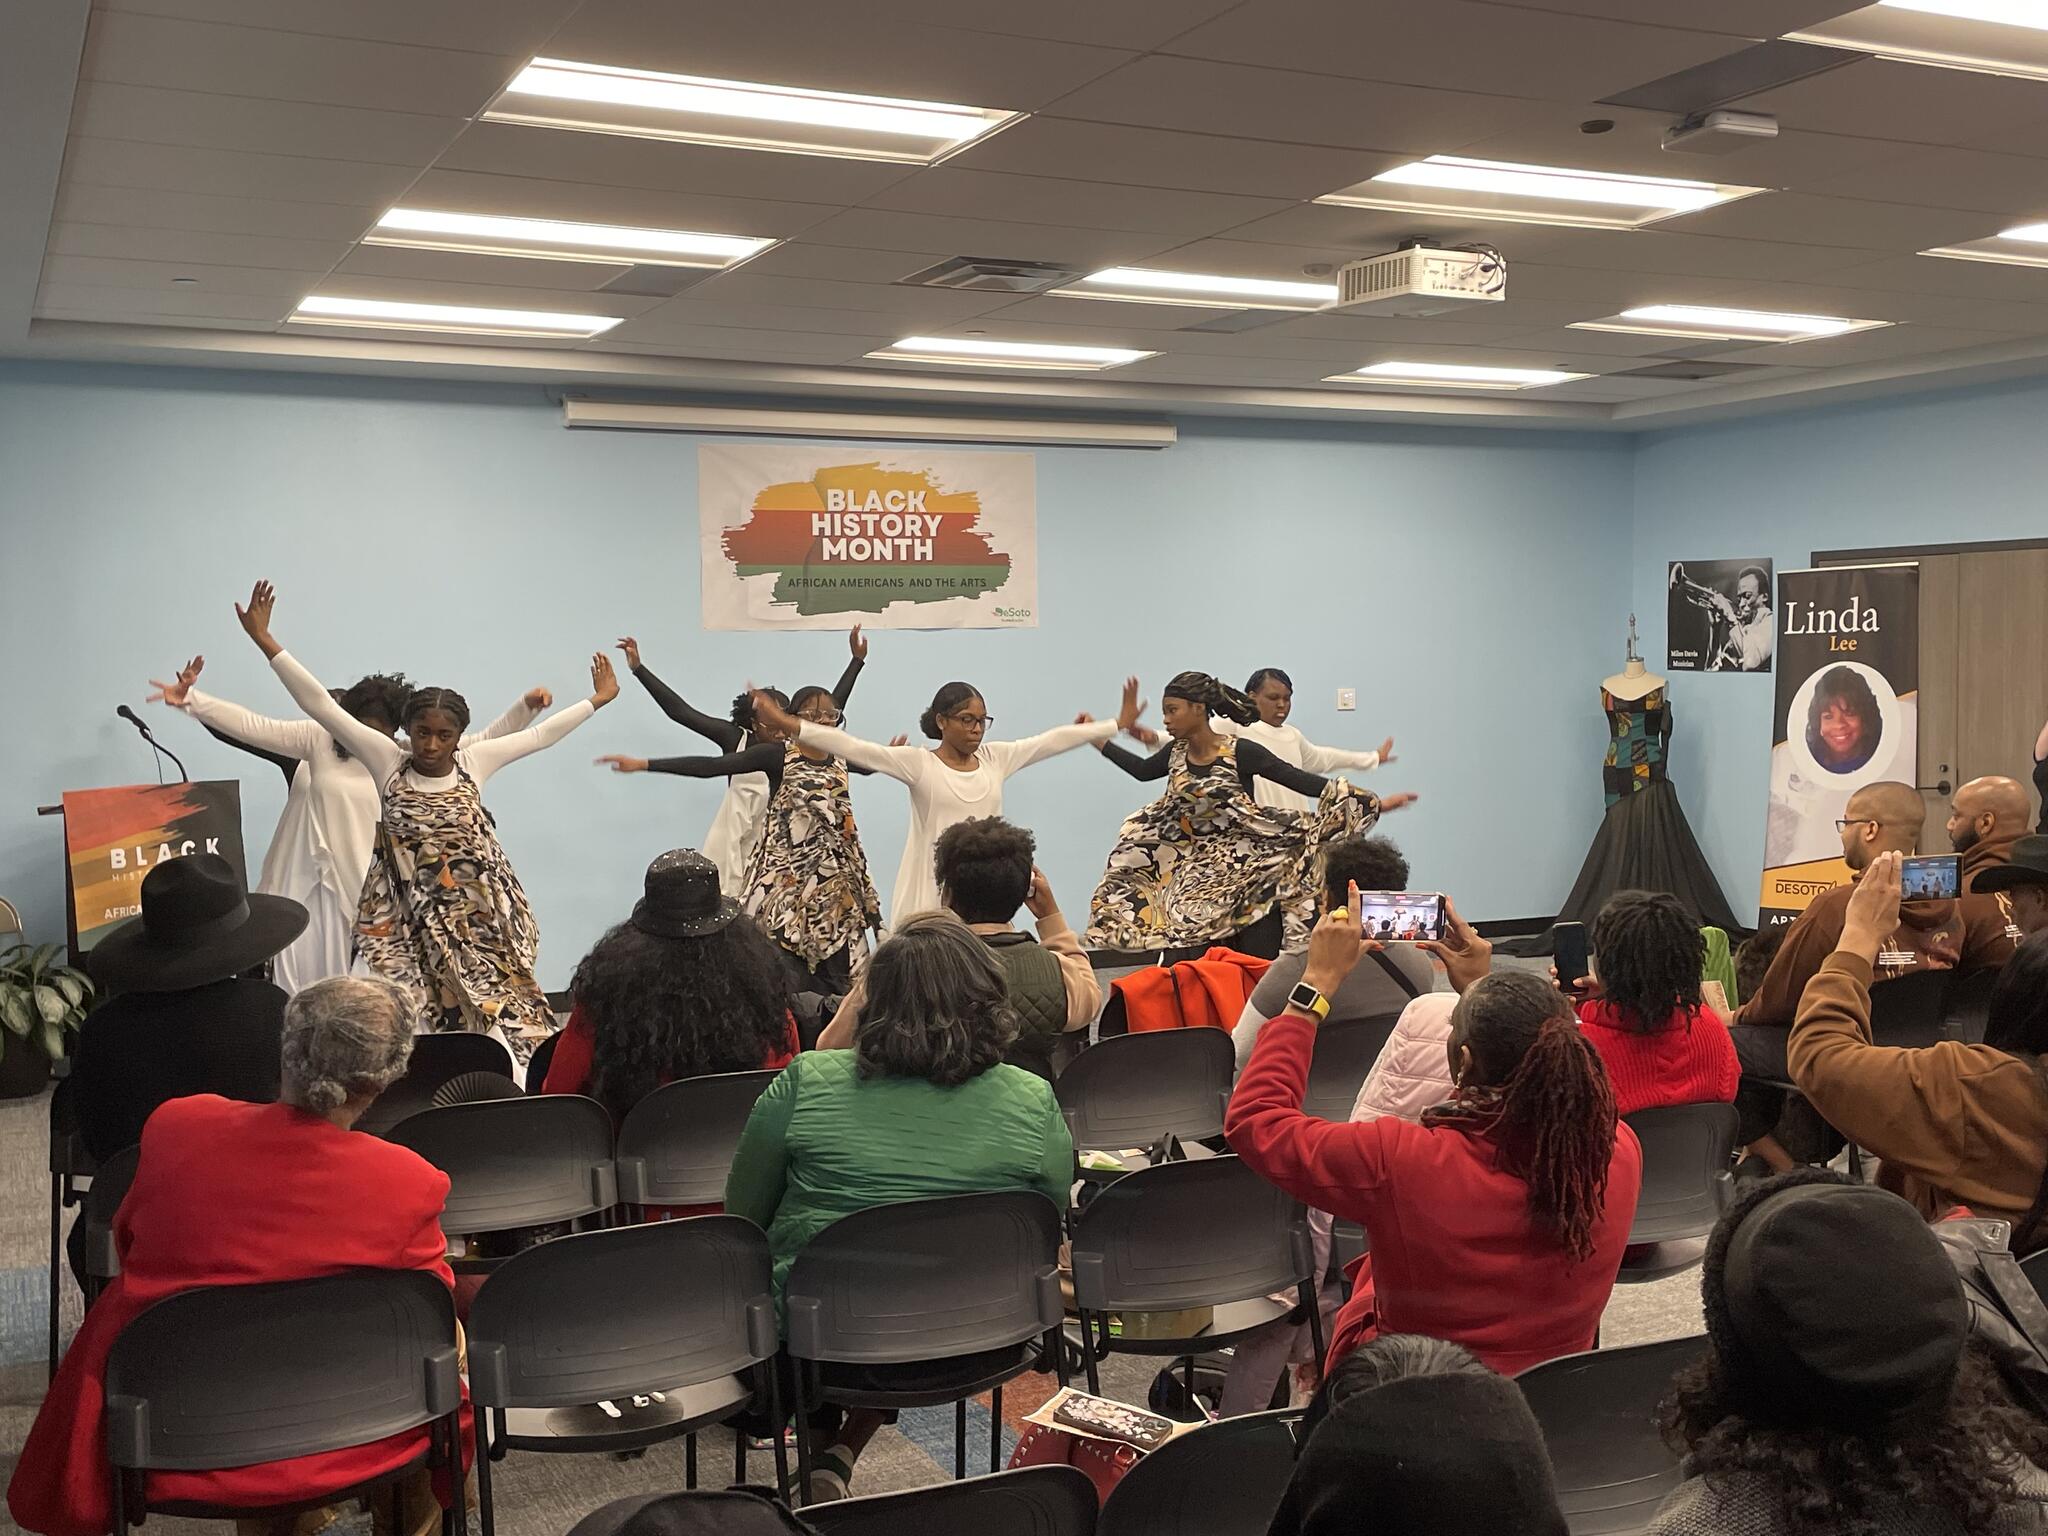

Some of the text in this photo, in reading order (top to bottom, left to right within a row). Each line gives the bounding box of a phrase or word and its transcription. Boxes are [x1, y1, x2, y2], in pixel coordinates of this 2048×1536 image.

[827, 488, 927, 513] BLACK
[811, 512, 943, 538] HISTORY
[822, 537, 933, 561] MONTH
[787, 577, 987, 588] AFRICAN AMERICANS AND THE ARTS
[1783, 595, 1880, 635] Linda
[1829, 634, 1858, 652] Lee
[110, 837, 220, 869] BLACK
[112, 870, 143, 882] HIST
[1775, 882, 1827, 896] DESOTO
[104, 903, 143, 920] AFRICA
